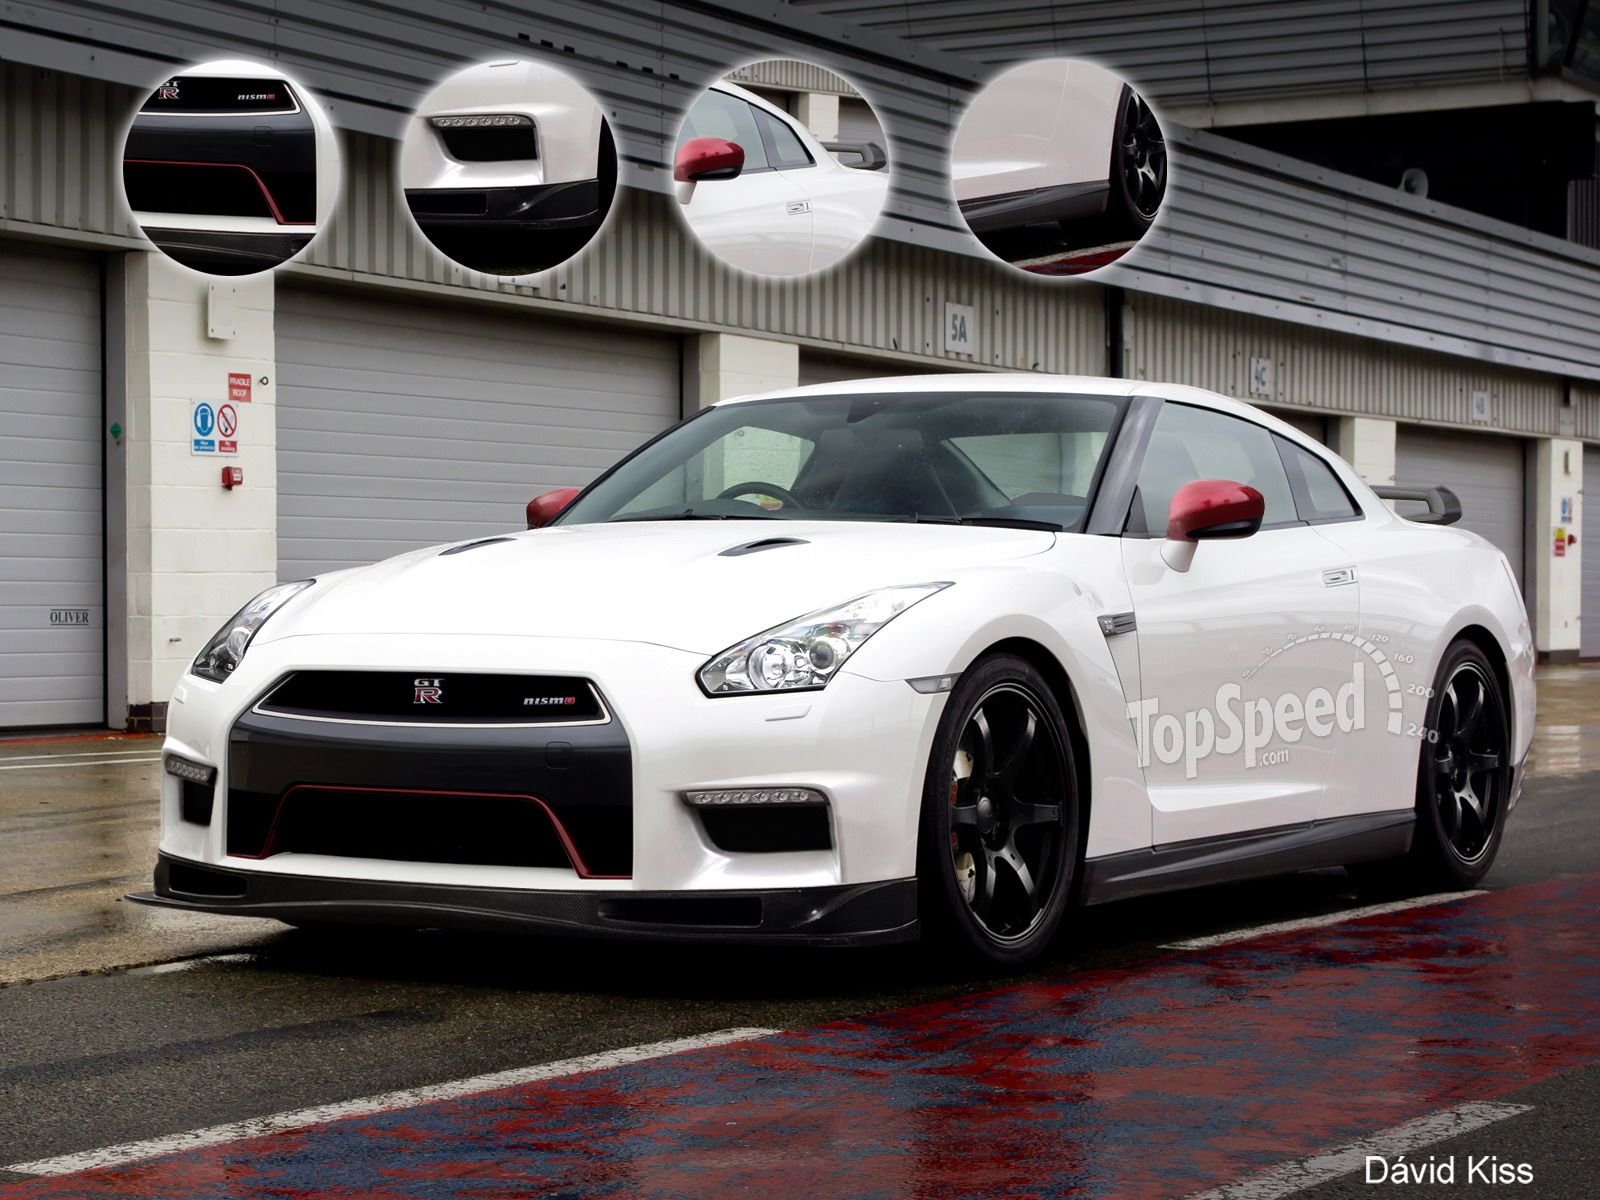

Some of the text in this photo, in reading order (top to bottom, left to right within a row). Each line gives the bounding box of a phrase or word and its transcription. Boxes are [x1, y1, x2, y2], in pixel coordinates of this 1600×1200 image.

[158, 86, 180, 99] R
[951, 312, 968, 343] 5A
[229, 376, 250, 387] FRAGILE
[232, 388, 248, 397] ROOF
[50, 611, 89, 623] OLIVER
[413, 678, 445, 687] GT
[413, 687, 443, 704] R
